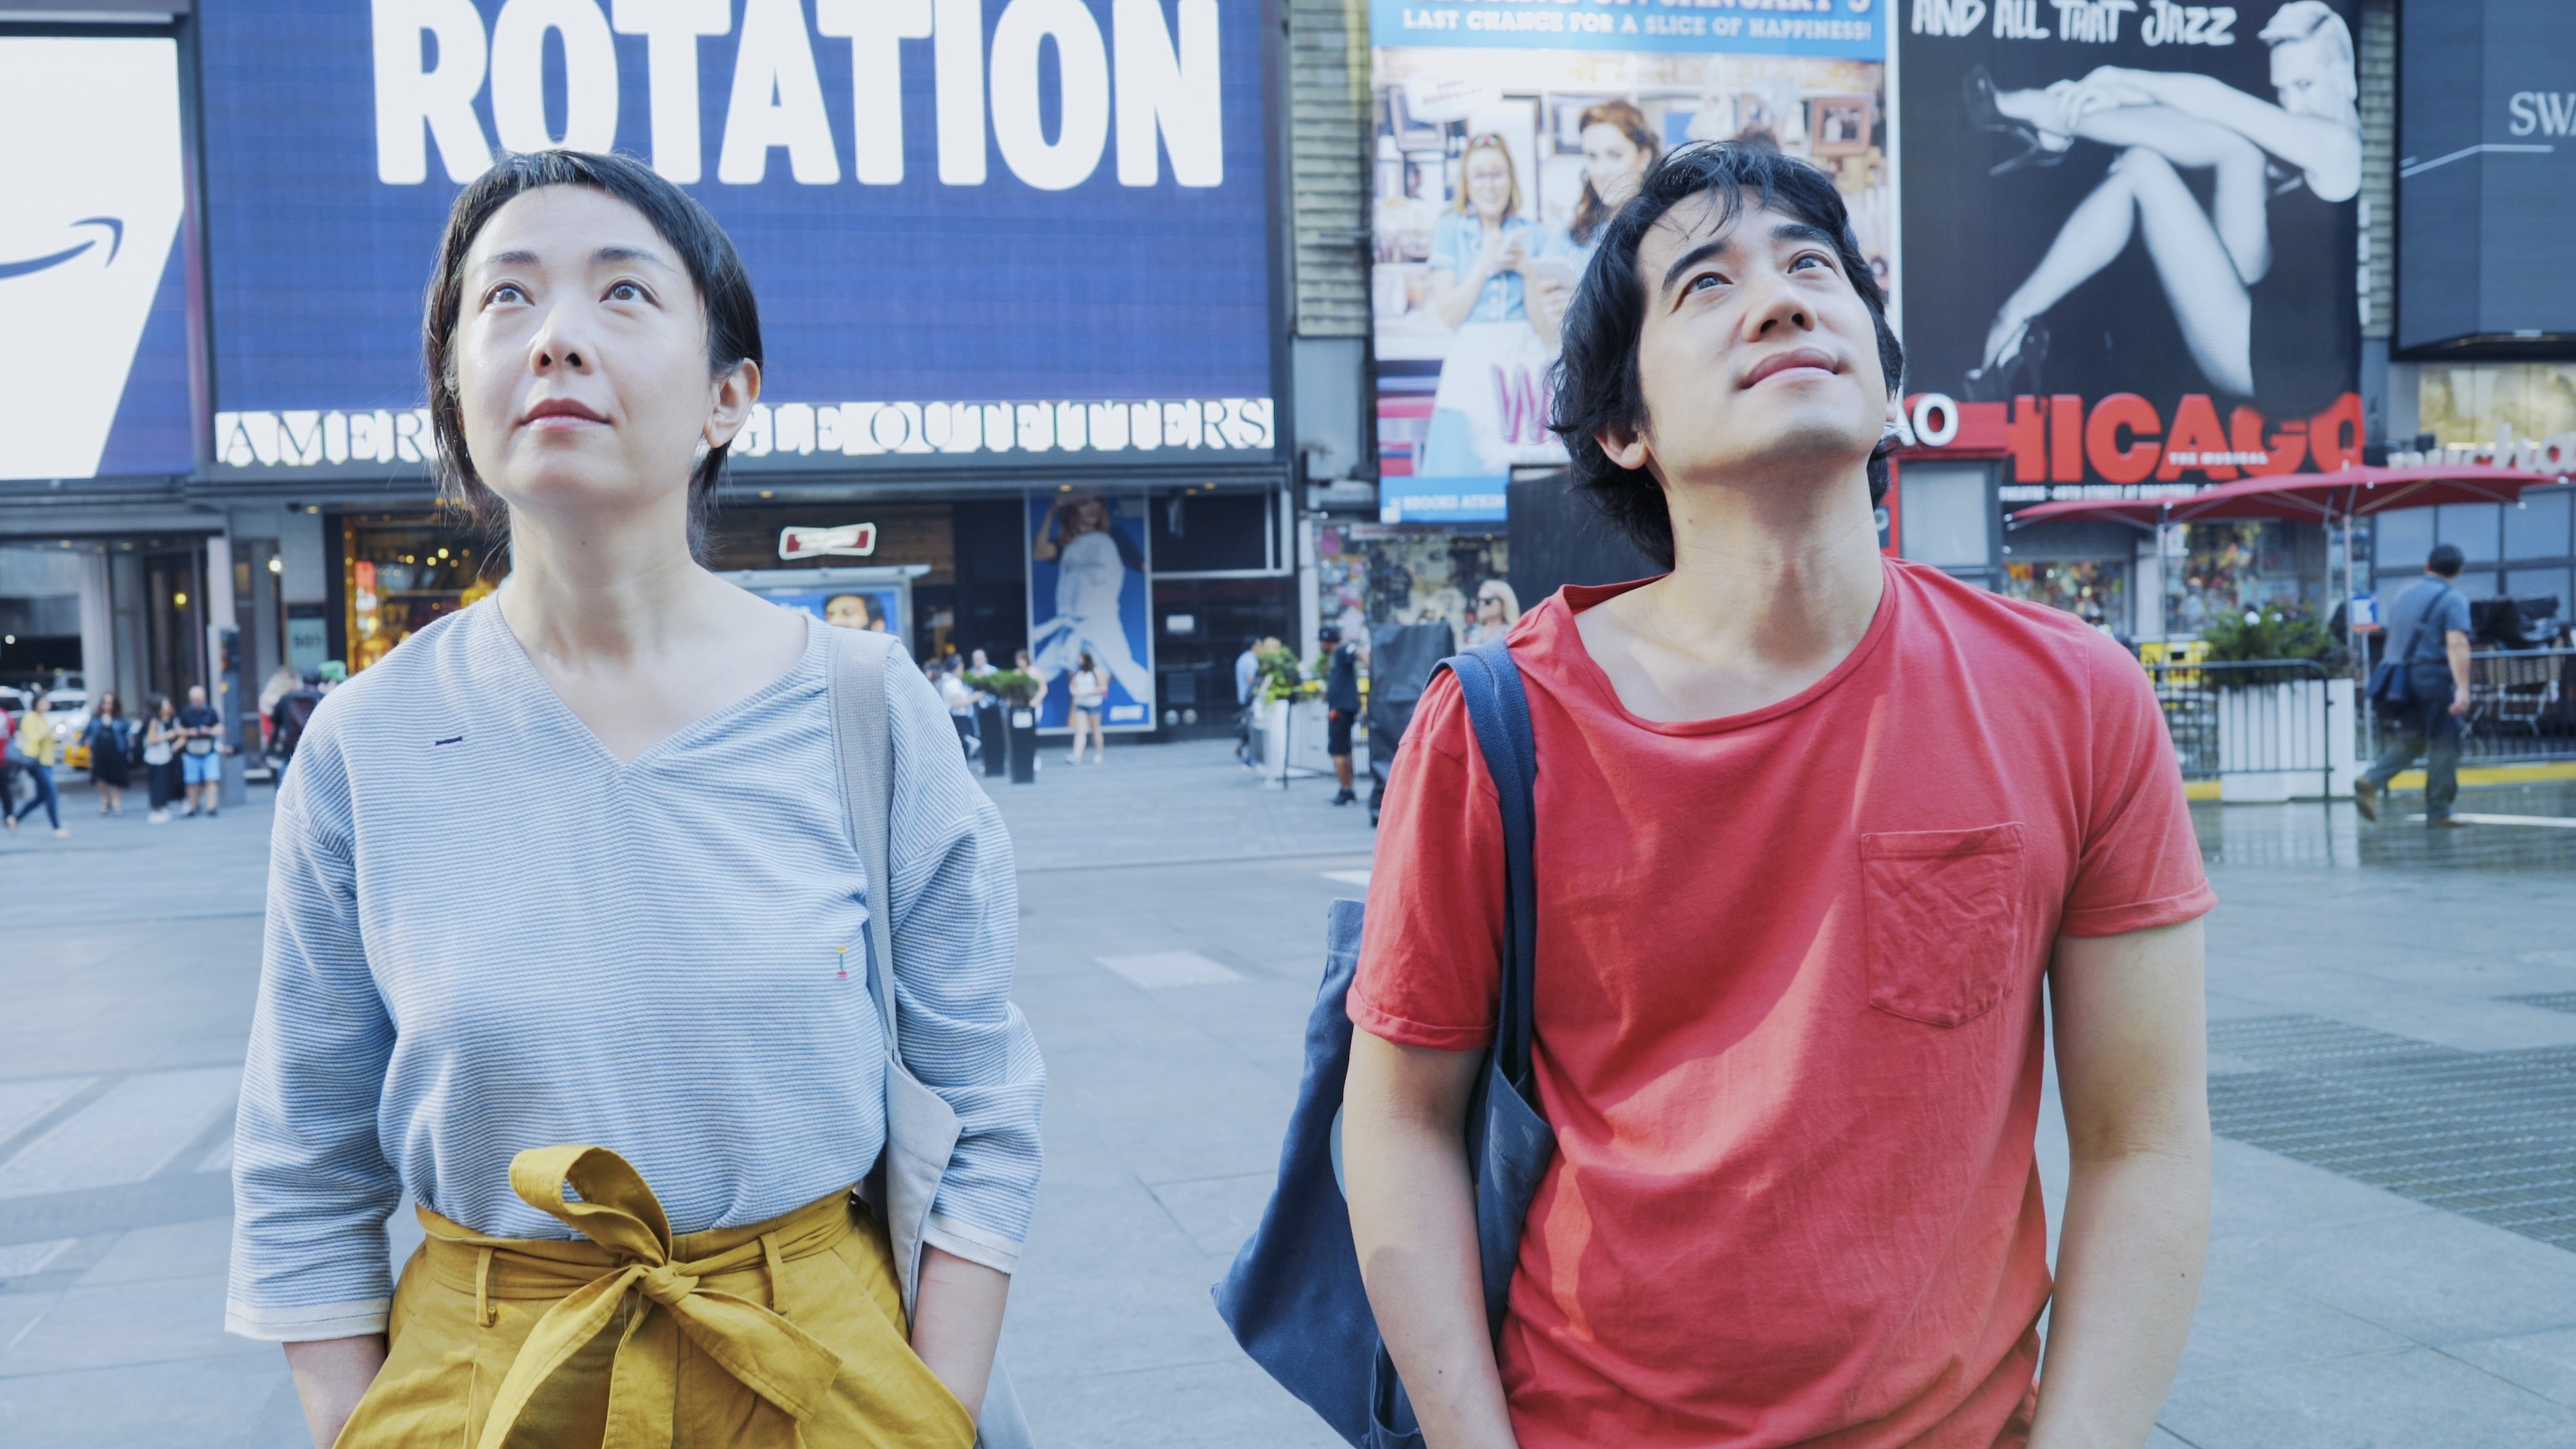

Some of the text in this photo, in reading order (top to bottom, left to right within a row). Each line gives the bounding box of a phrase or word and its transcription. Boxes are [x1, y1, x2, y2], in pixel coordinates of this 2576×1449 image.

[1403, 9, 1872, 41] LAST CHANCE FOR A SLICE OF HAPPINESS!
[1912, 0, 2237, 46] AND ALL THAT JAZZ
[372, 0, 1224, 191] ROTATION
[216, 410, 435, 466] AMER
[868, 397, 1273, 453] OUTFITTERS
[2004, 391, 2367, 484] HICAGO
